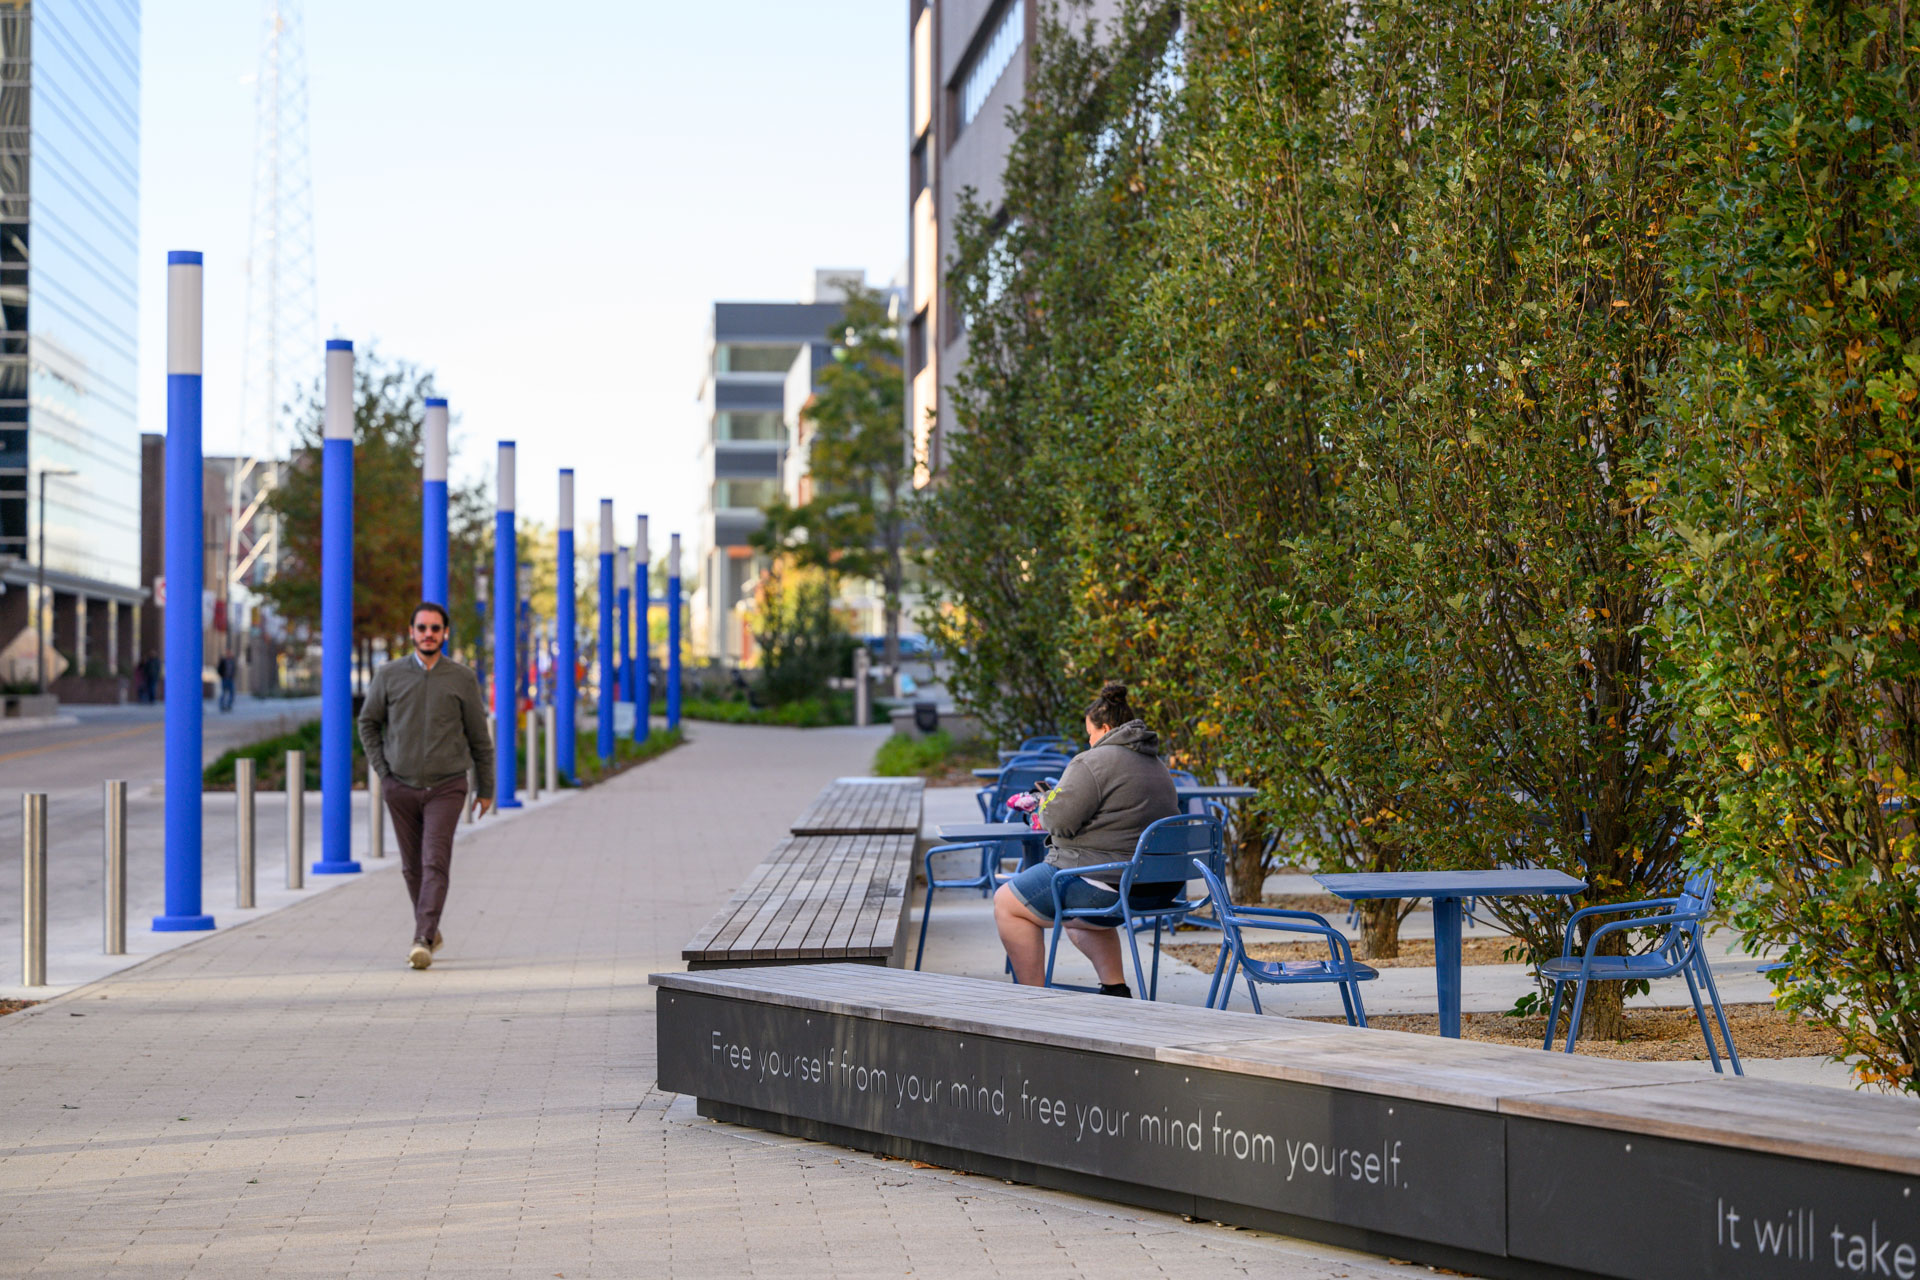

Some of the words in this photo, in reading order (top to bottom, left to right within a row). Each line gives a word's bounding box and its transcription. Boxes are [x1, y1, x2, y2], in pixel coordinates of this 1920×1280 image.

[711, 1030, 751, 1071] Free
[757, 1047, 834, 1085] yourself
[840, 1049, 888, 1095] from
[895, 1071, 942, 1109] your
[950, 1073, 1012, 1125] mind,
[1020, 1079, 1067, 1127] free
[1075, 1101, 1130, 1142] your
[1139, 1105, 1202, 1152] mind
[1212, 1110, 1275, 1165] from
[1285, 1138, 1409, 1189] yourself.
[1716, 1197, 1741, 1250] It
[1753, 1207, 1815, 1263] will
[1830, 1218, 1917, 1280] take
